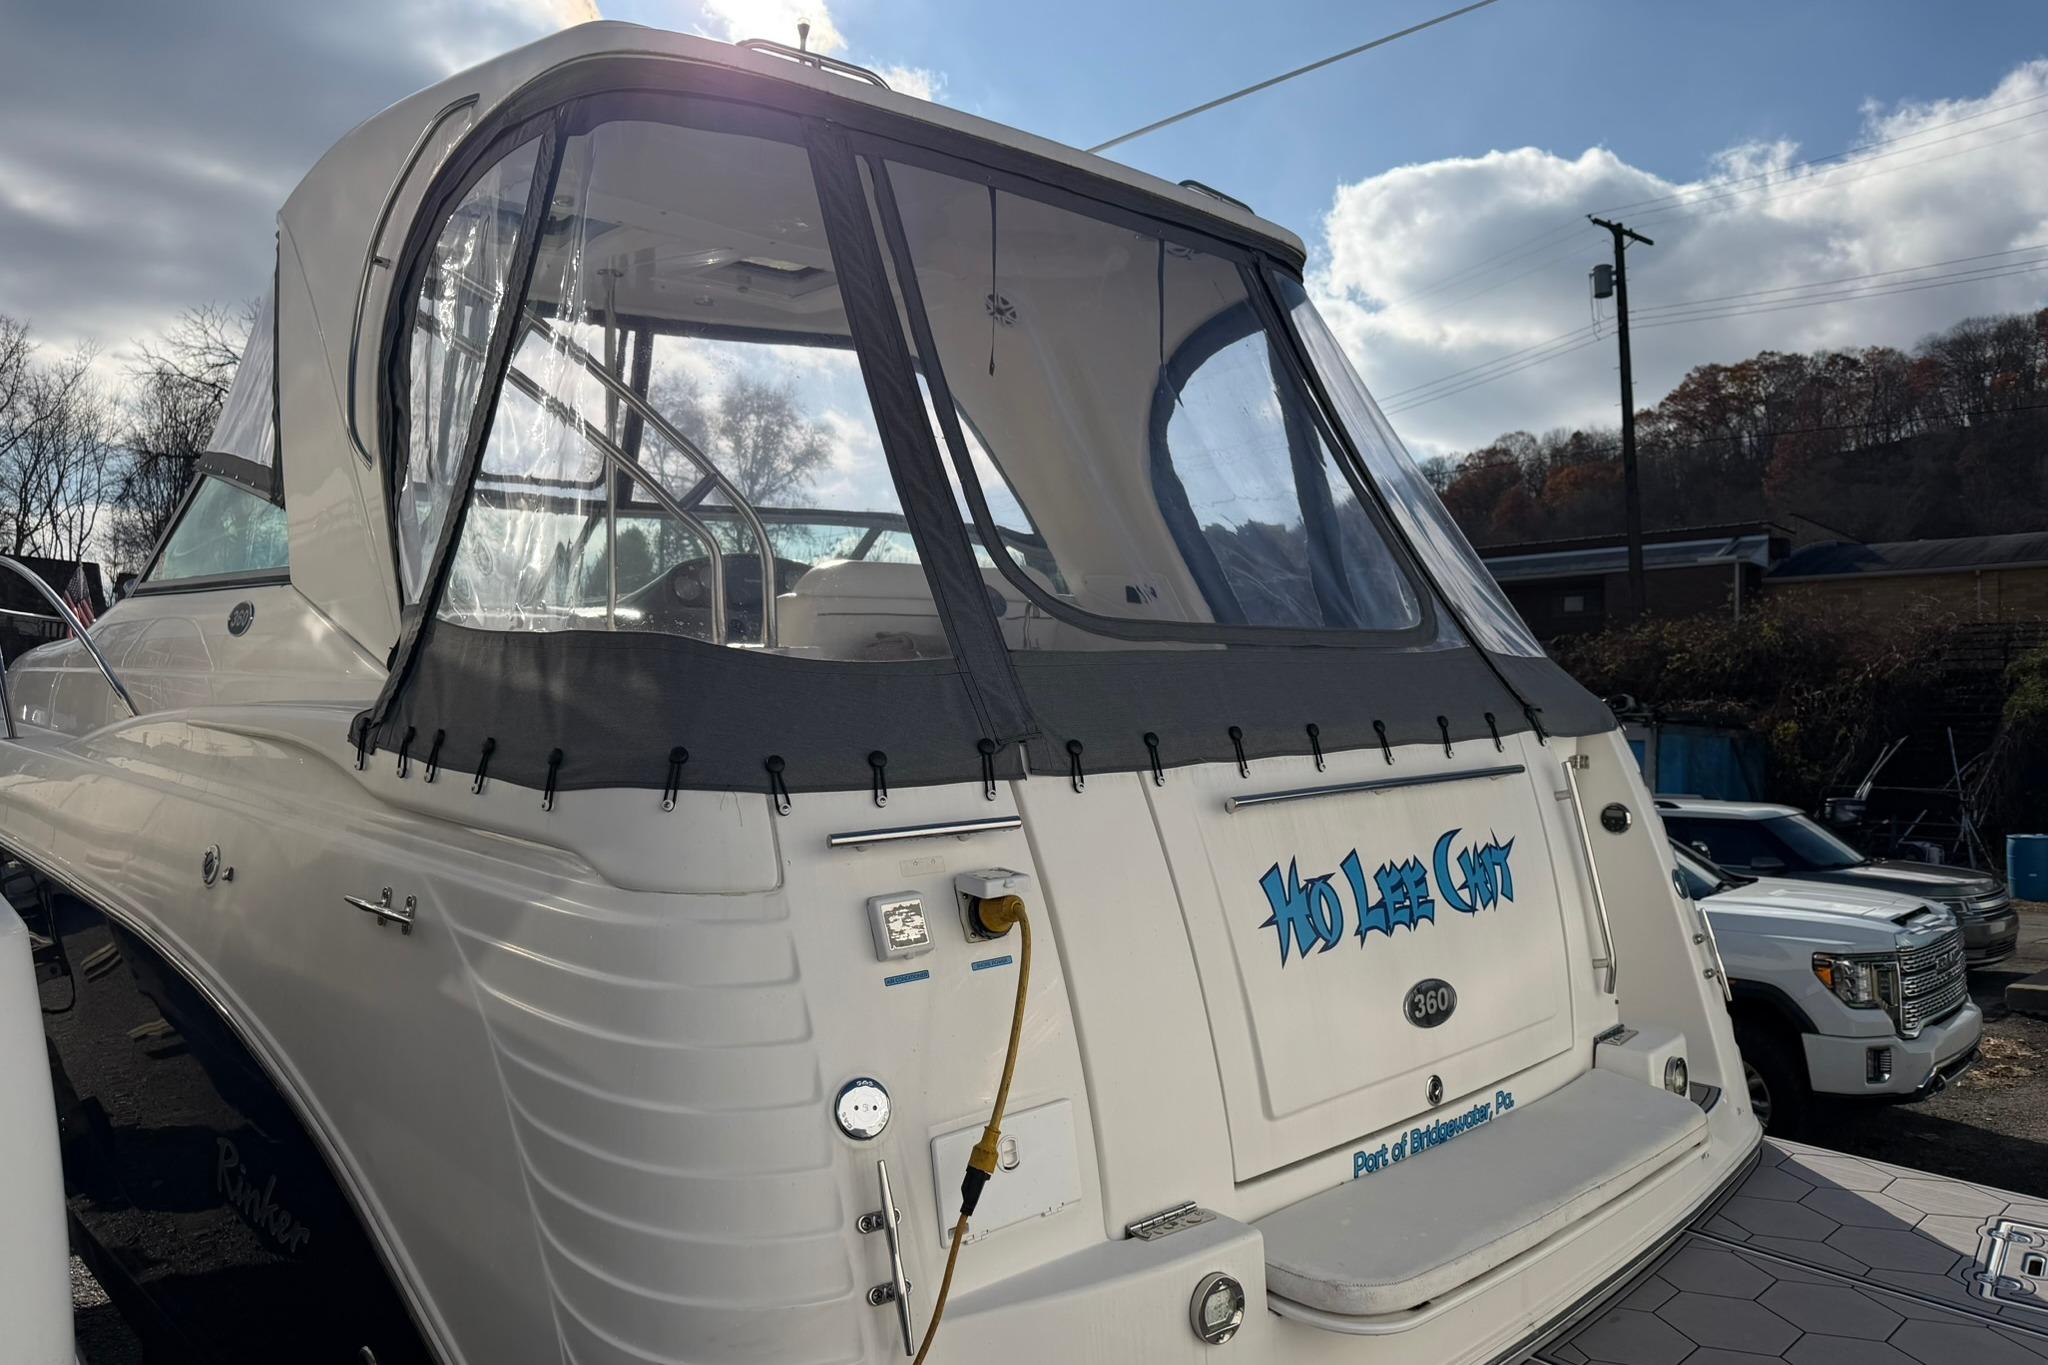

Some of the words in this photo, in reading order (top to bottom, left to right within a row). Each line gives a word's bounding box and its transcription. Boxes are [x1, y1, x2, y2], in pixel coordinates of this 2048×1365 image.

[231, 609, 250, 628] 360
[1414, 987, 1449, 1018] 360
[1353, 1143, 1388, 1178] Port
[1391, 1131, 1407, 1162] of
[1410, 1102, 1493, 1154] Bridgewater,
[1495, 1090, 1514, 1114] Pa.
[216, 1137, 311, 1252] Rinker
